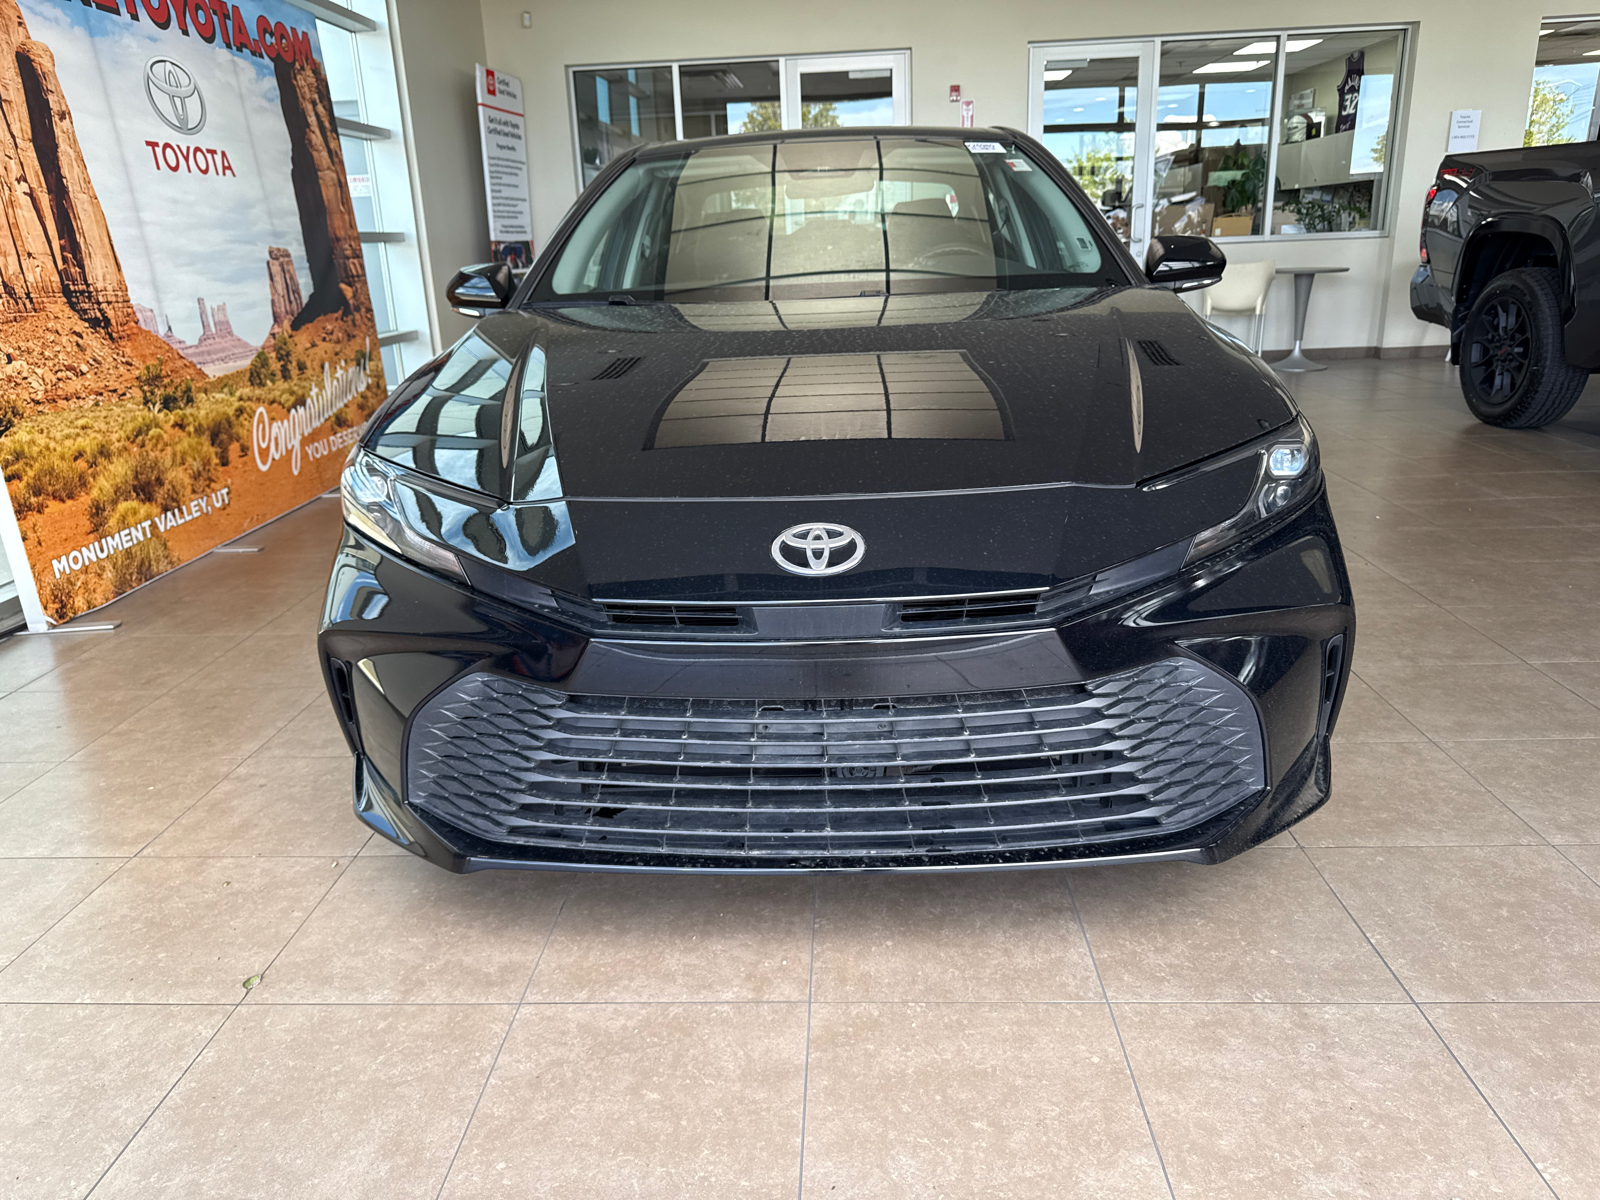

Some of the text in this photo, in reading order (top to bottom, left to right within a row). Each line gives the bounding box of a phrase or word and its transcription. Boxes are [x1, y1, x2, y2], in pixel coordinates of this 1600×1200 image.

[1341, 93, 1358, 115] 32
[144, 140, 237, 178] TOYOTA
[253, 336, 372, 476] Congratulations!
[305, 438, 329, 462] YOU
[51, 487, 230, 580] MONUMENT VALLEY, UT
